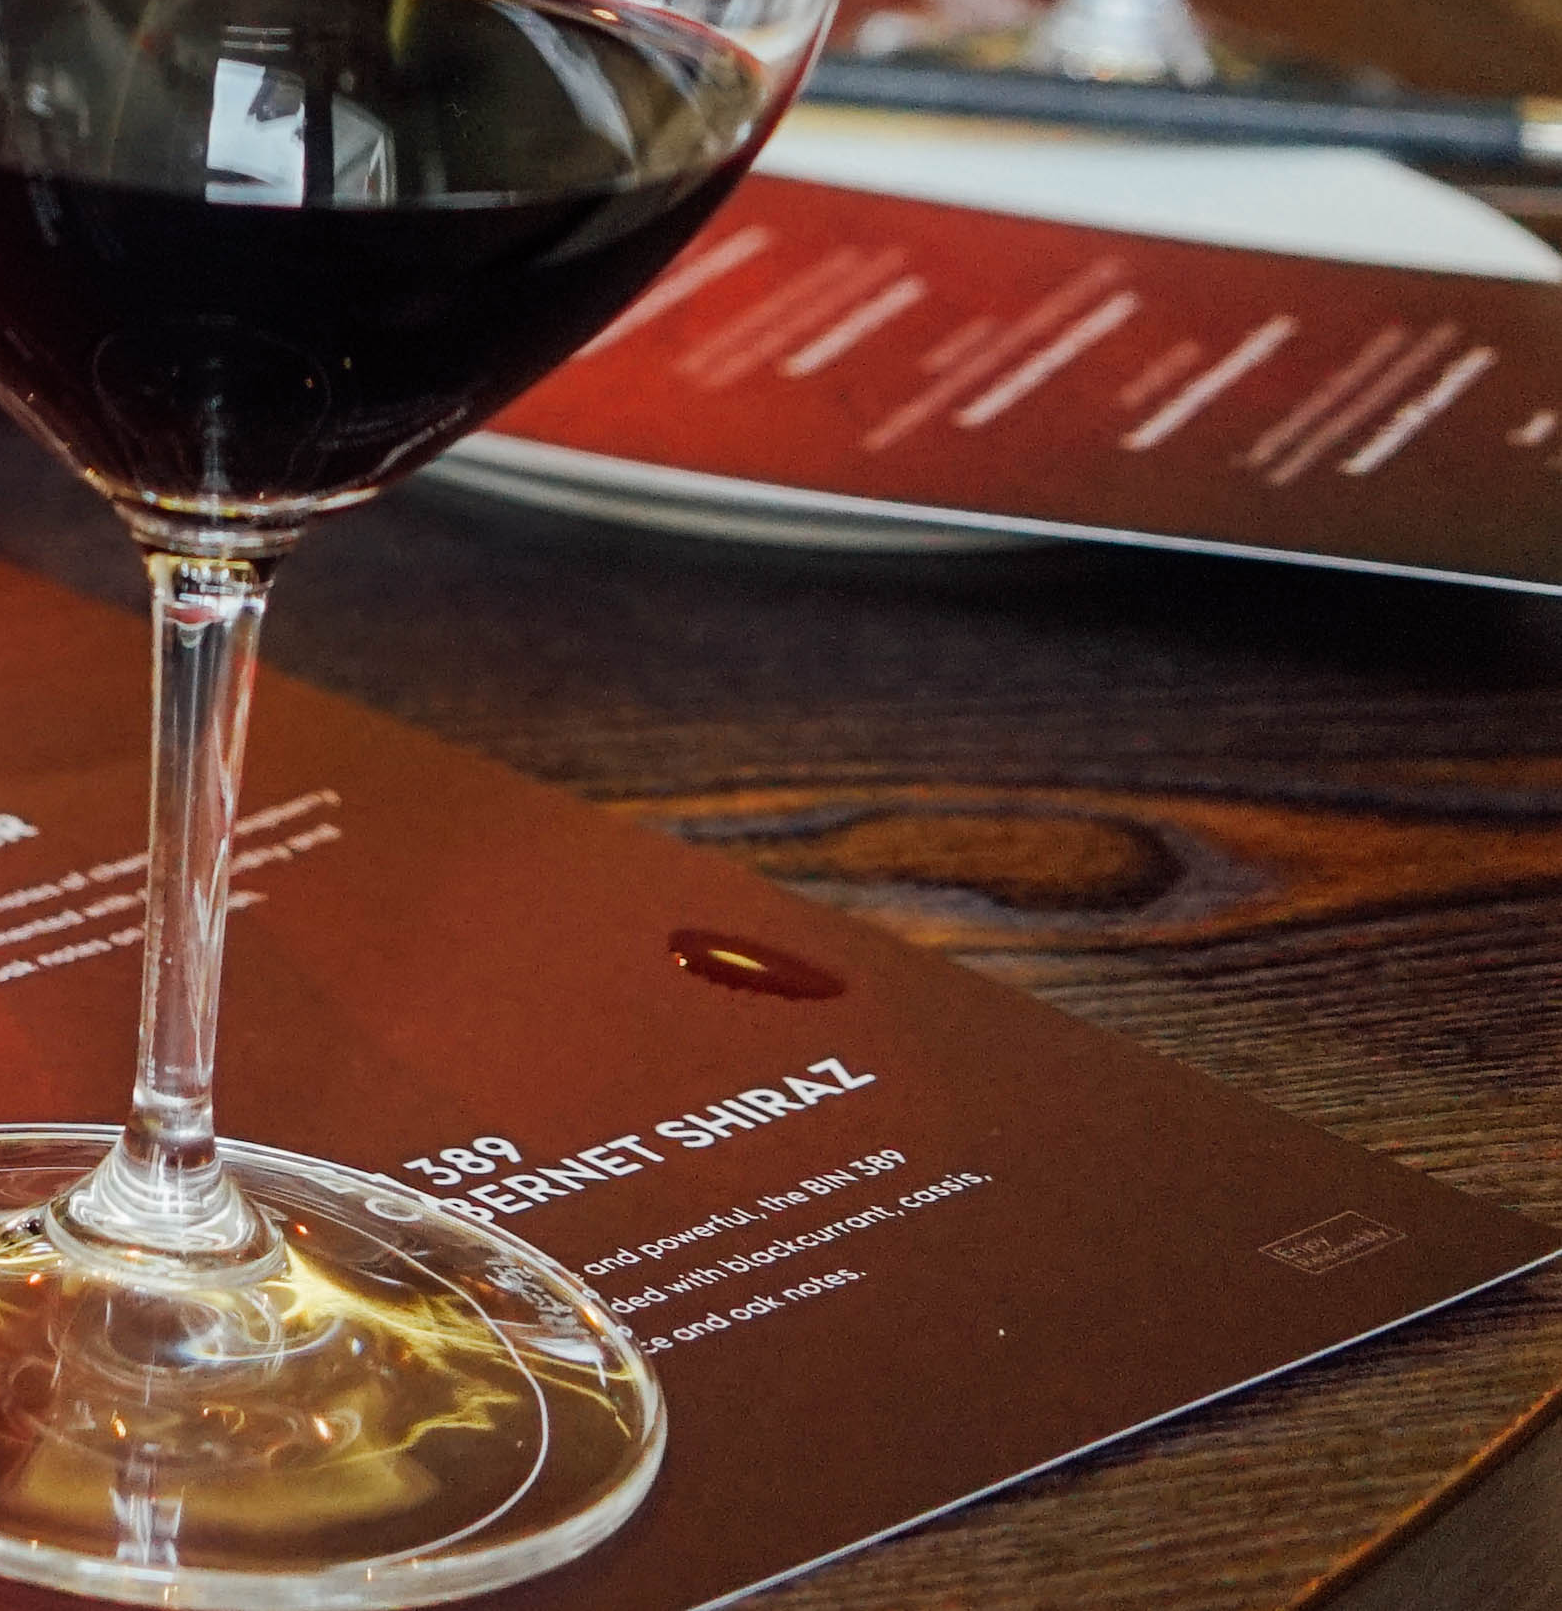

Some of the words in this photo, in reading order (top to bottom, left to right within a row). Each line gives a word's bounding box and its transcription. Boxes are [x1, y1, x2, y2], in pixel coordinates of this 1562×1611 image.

[364, 1134, 664, 1225] CBERNET
[656, 1058, 876, 1148] SHIRAZ
[403, 1136, 522, 1186] 389
[584, 1249, 640, 1276] and
[639, 1207, 768, 1260] powerful,
[759, 1187, 810, 1212] the
[800, 1168, 851, 1197] BIN
[852, 1149, 907, 1178] 389
[669, 1268, 721, 1296] with
[723, 1207, 905, 1275] blackcurrant,
[898, 1171, 992, 1208] cassis,
[673, 1313, 731, 1340] and
[730, 1293, 785, 1321] oak
[782, 1265, 867, 1301] notes.
